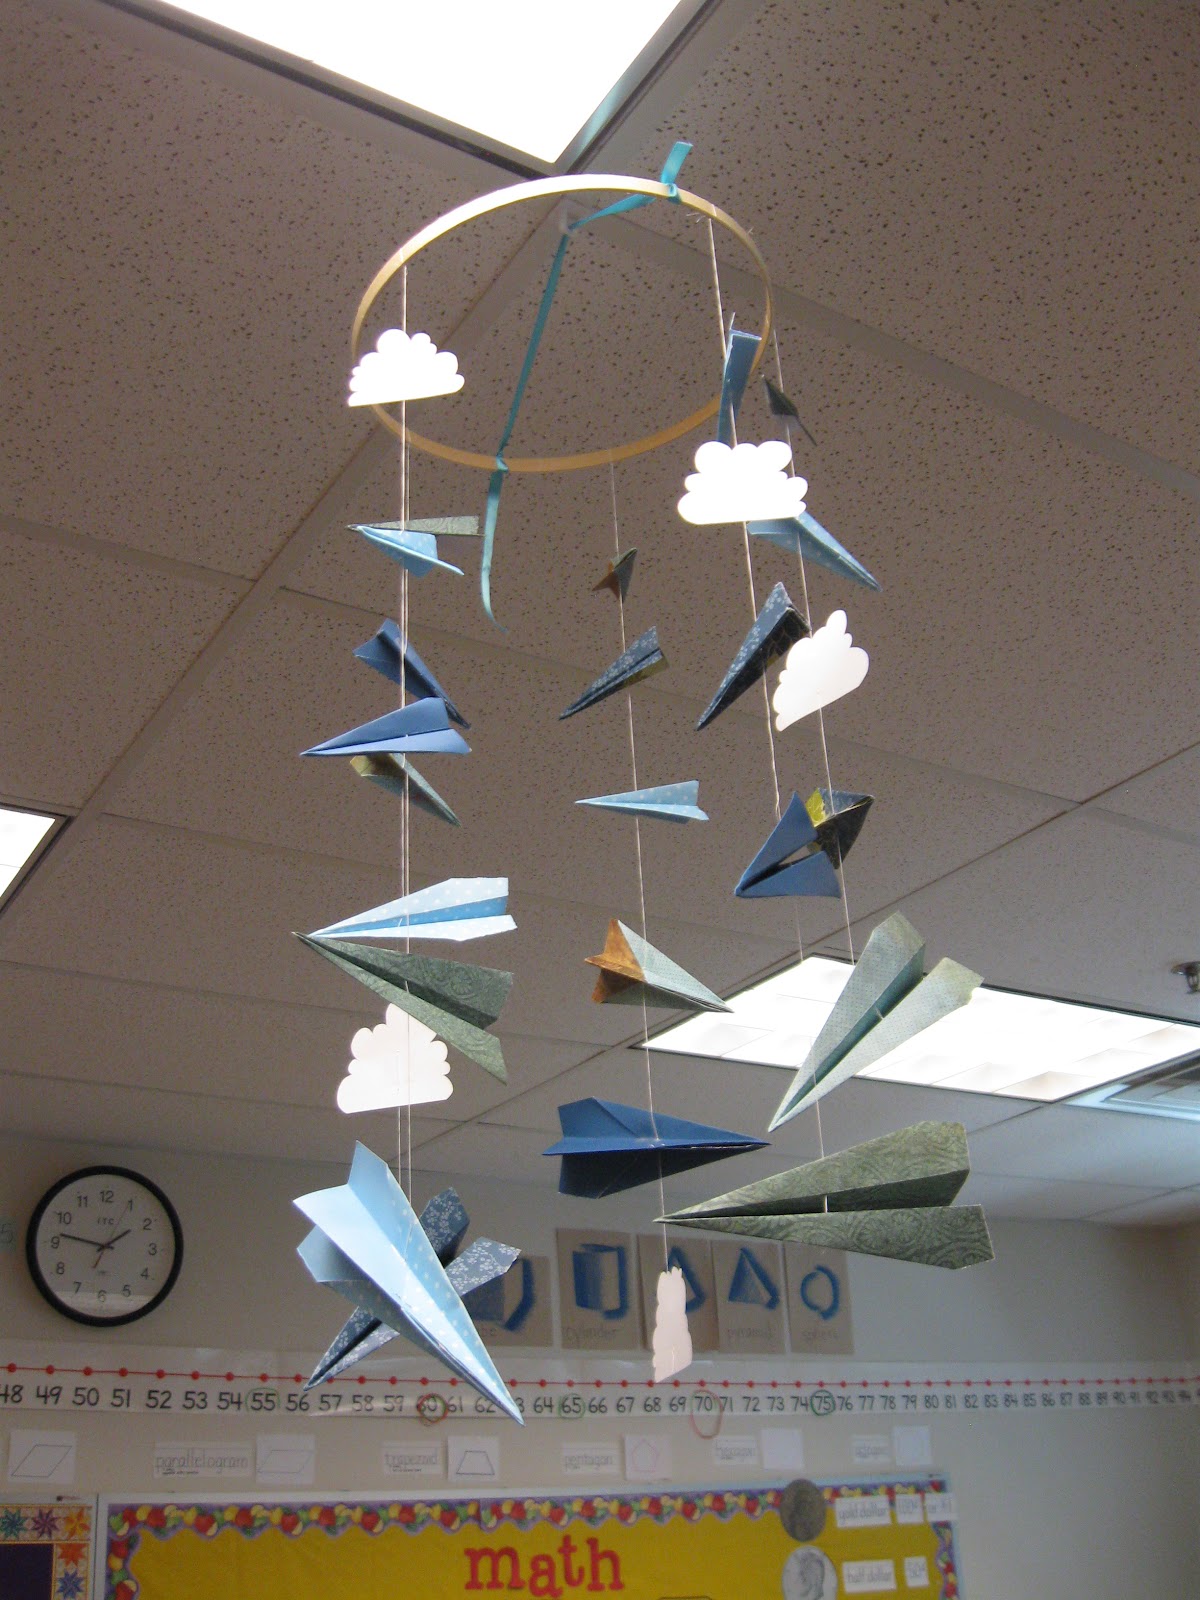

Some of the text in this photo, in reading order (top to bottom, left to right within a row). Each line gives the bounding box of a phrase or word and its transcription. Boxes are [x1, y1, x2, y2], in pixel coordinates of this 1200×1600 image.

[77, 1196, 88, 1208] 11
[100, 1191, 114, 1203] 12
[128, 1200, 133, 1211] 1
[58, 1212, 72, 1225] 10
[143, 1219, 152, 1231] 2
[51, 1237, 60, 1249] 9
[149, 1243, 157, 1255] 3
[56, 1262, 65, 1275] 8
[141, 1268, 149, 1280] 4
[73, 1282, 82, 1294] 7
[123, 1285, 131, 1297] 5
[98, 1290, 107, 1302] 6
[0, 1384, 23, 1404] 48
[36, 1386, 63, 1405] 49
[72, 1387, 100, 1406] 50
[110, 1388, 131, 1407] 51
[145, 1390, 172, 1409] 52
[182, 1391, 208, 1410] 53
[217, 1392, 243, 1411] 54
[250, 1393, 276, 1411] 55
[285, 1393, 310, 1412] 56
[318, 1394, 342, 1412] 57
[352, 1394, 374, 1412] 58
[383, 1395, 404, 1412] 59
[448, 1395, 463, 1413] 61
[474, 1397, 496, 1413] 62
[533, 1397, 553, 1413] 64
[561, 1397, 582, 1413] 65
[589, 1397, 608, 1413] 66
[616, 1397, 635, 1413] 67
[643, 1397, 662, 1412] 68
[669, 1397, 686, 1412] 69
[695, 1396, 713, 1412] 70
[721, 1396, 733, 1412] 71
[743, 1396, 761, 1412] 72
[767, 1396, 784, 1412] 73
[791, 1396, 809, 1412] 74
[816, 1395, 832, 1411] 75
[837, 1395, 853, 1411] 76
[859, 1395, 874, 1411] 77
[880, 1395, 896, 1410] 78
[902, 1394, 917, 1410] 79
[924, 1394, 939, 1409] 80
[944, 1394, 957, 1409] 81
[964, 1394, 979, 1409] 82
[984, 1393, 999, 1408] 83
[1004, 1393, 1018, 1408] 84
[1023, 1392, 1036, 1407] 85
[156, 1449, 249, 1474] parallelogram
[464, 1535, 624, 1598] math
